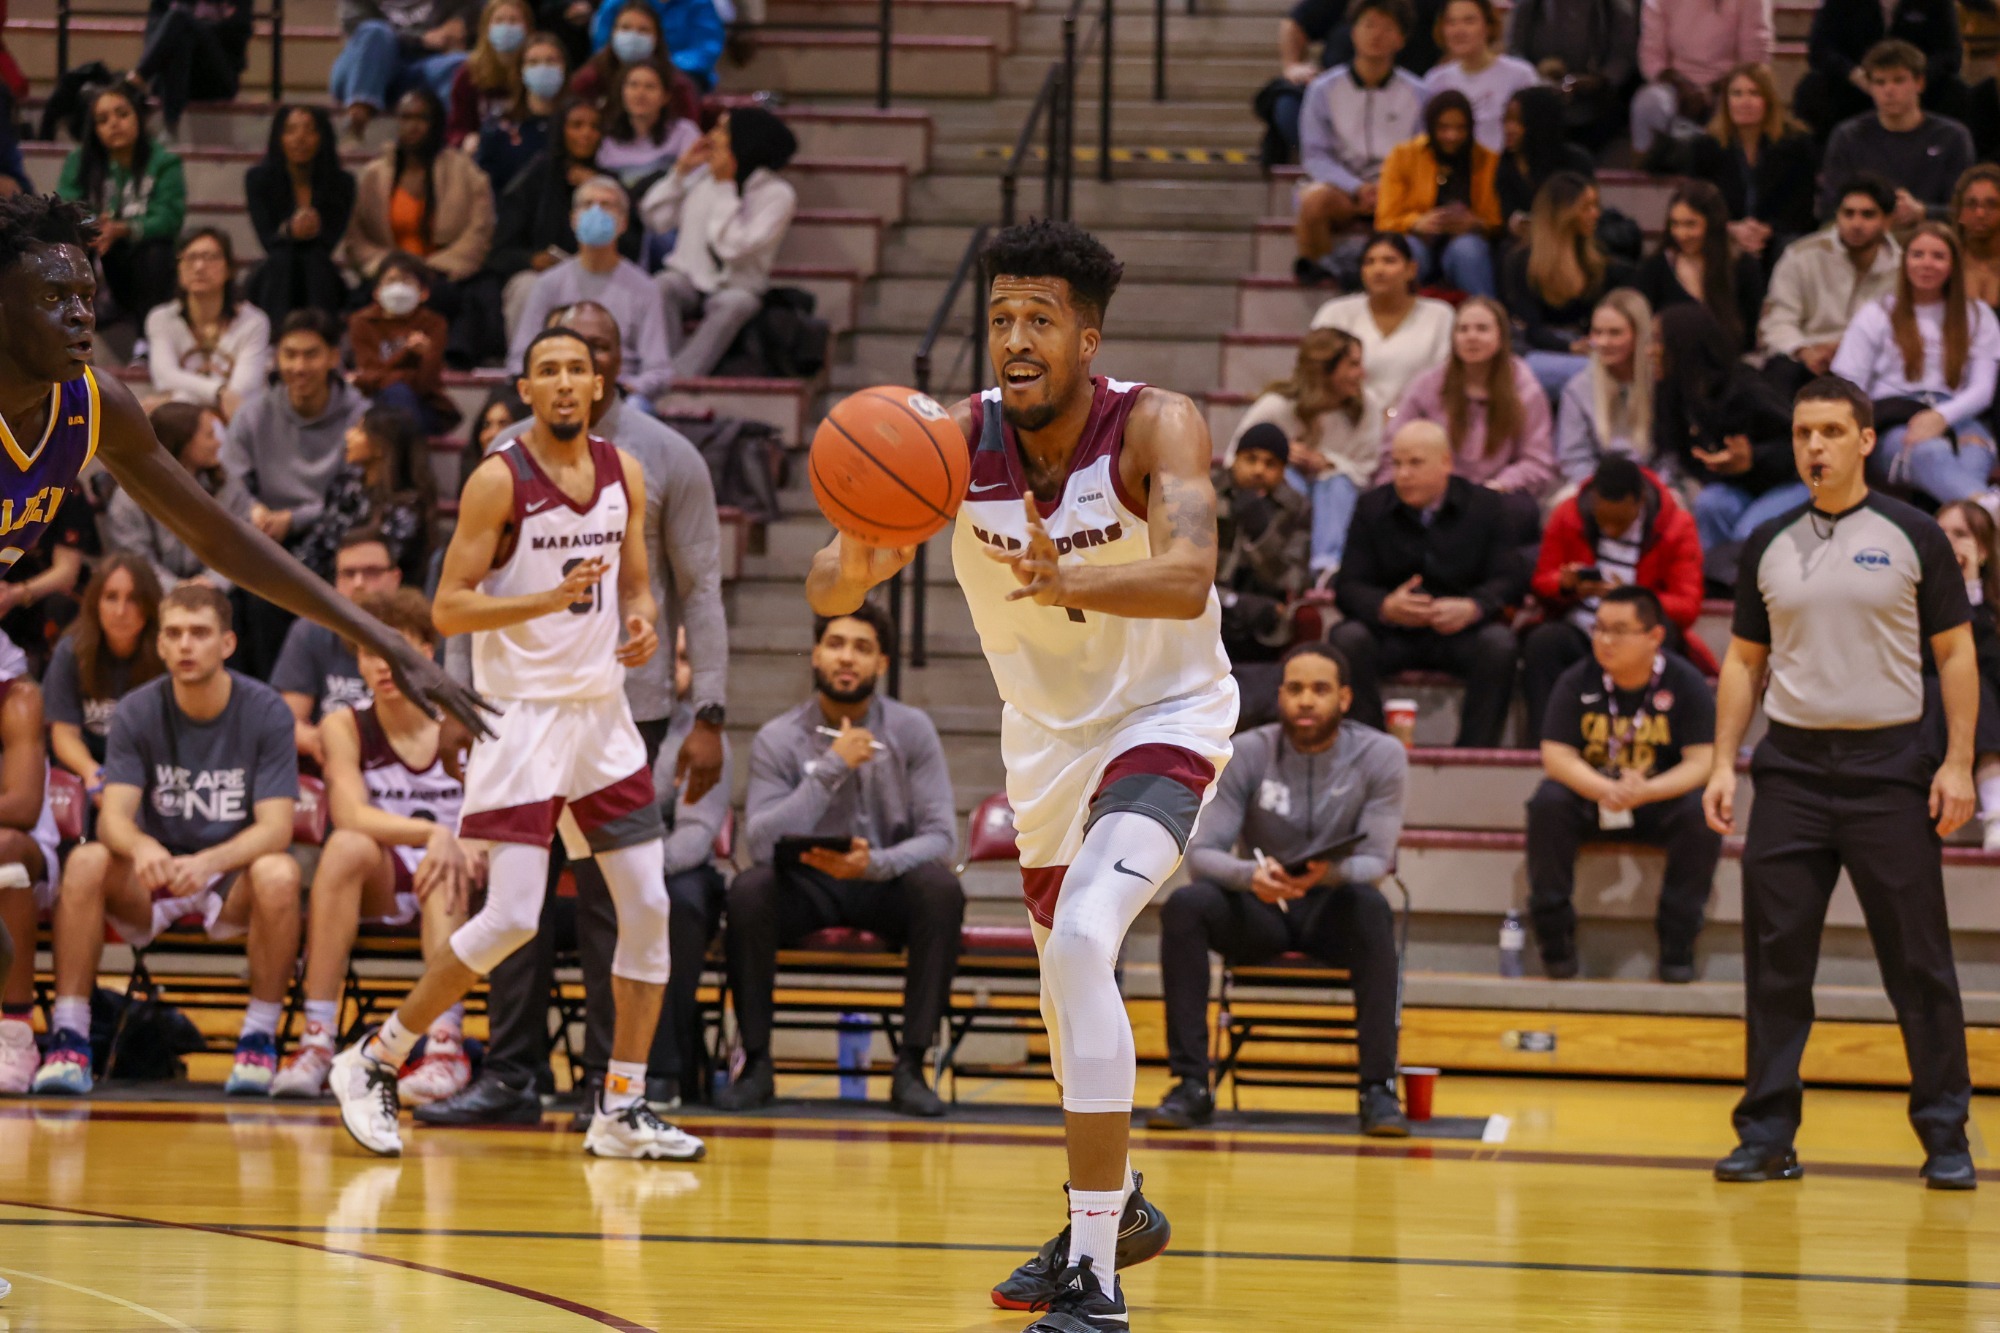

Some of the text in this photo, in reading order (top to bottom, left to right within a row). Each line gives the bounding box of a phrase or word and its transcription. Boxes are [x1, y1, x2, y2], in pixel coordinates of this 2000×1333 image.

[1078, 492, 1104, 504] OUA
[972, 521, 1123, 556] MARDERS
[155, 764, 245, 791] WE ARE
